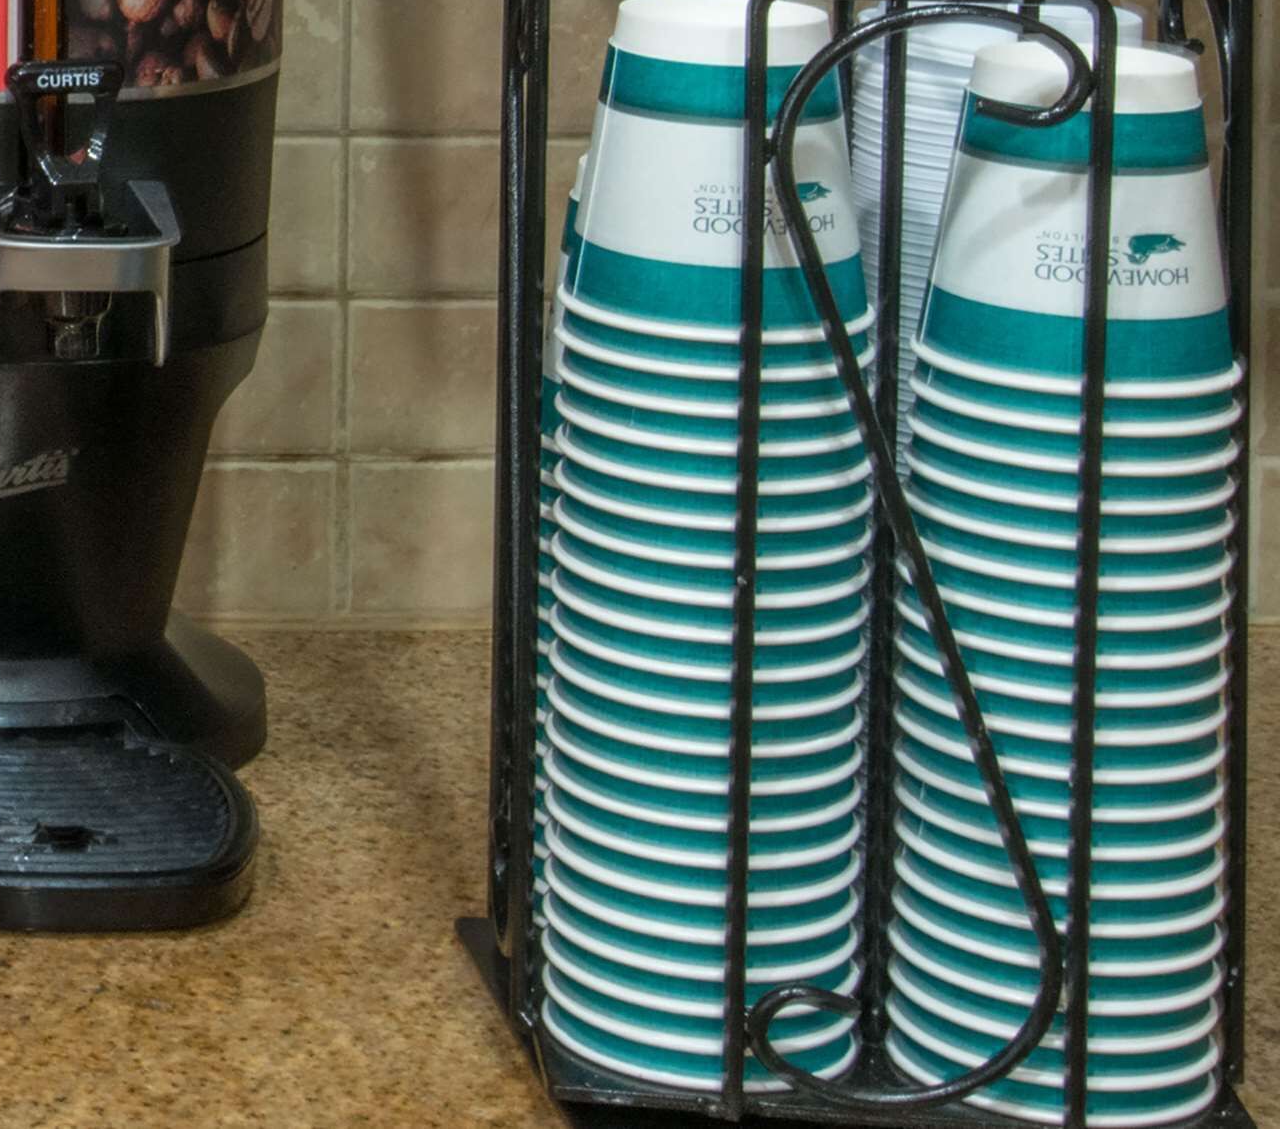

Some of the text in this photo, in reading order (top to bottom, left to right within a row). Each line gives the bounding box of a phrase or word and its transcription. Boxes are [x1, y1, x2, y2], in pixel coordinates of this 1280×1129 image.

[37, 72, 100, 88] CURTIS
[694, 196, 773, 216] SITES
[1036, 243, 1119, 267] SITES
